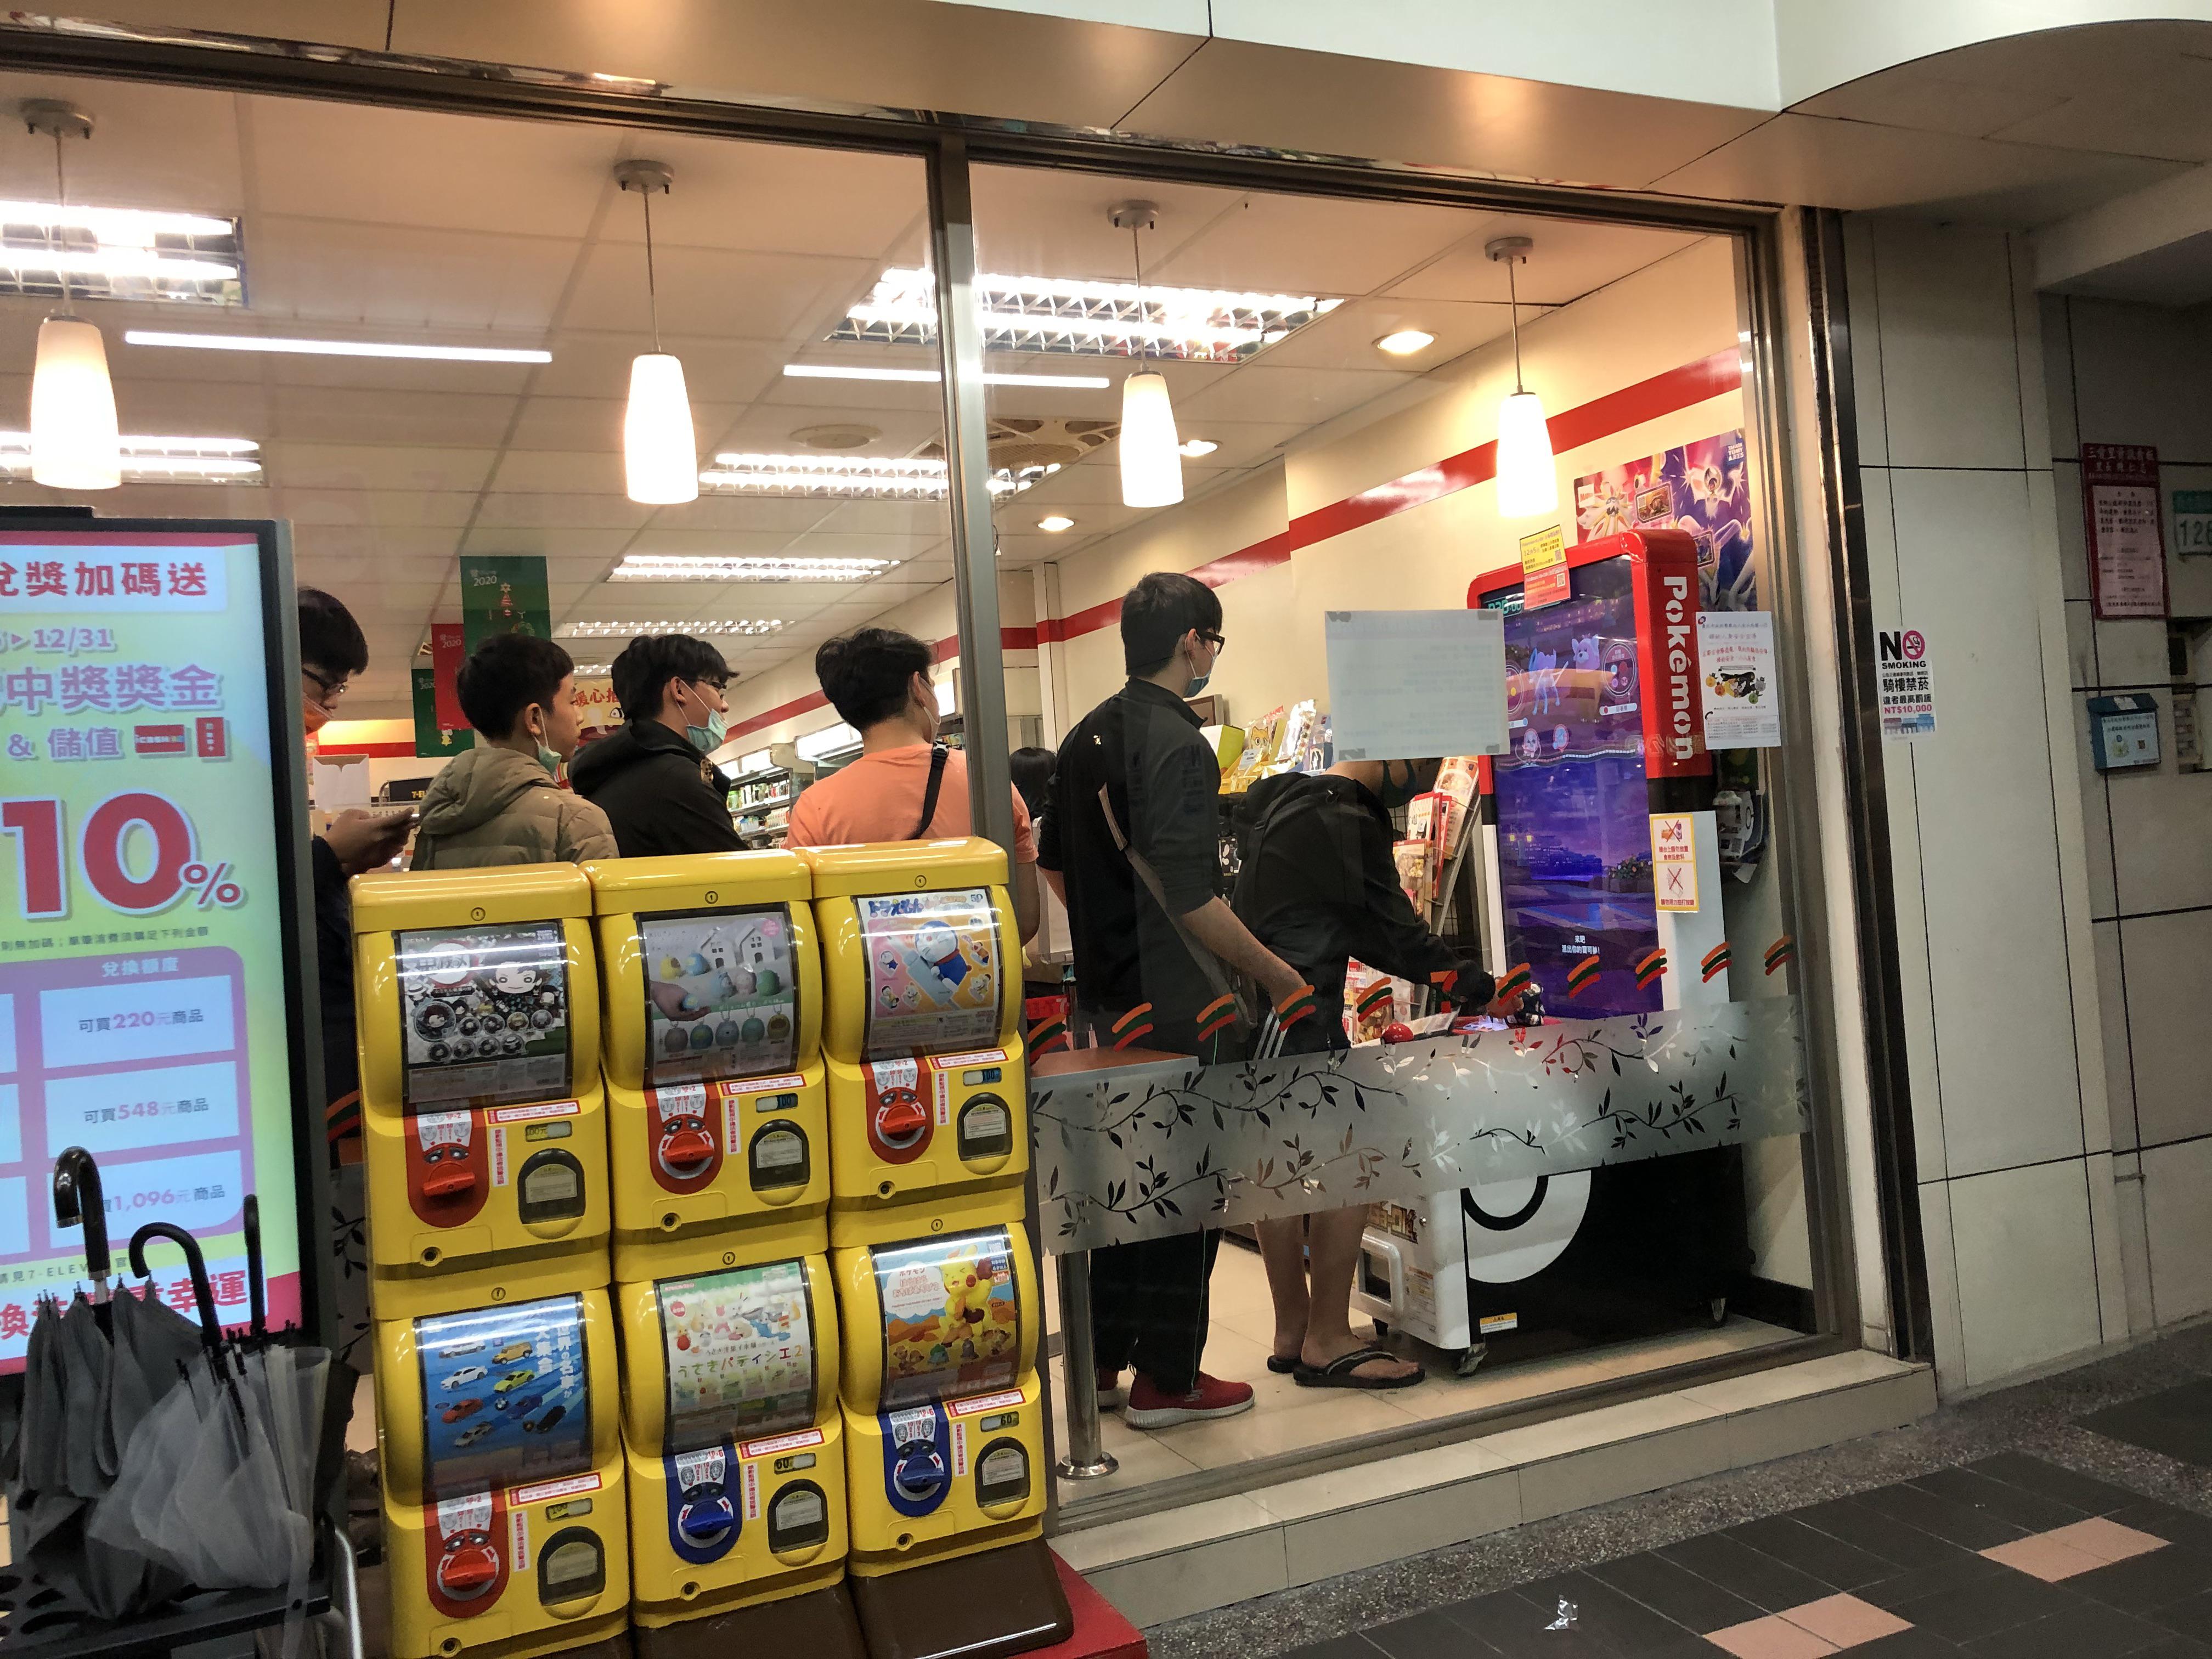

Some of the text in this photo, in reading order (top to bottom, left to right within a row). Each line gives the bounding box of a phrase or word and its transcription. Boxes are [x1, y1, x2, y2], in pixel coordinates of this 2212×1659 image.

[473, 575, 497, 586] 2020
[442, 639, 461, 648] 2020
[1663, 577, 1694, 760] Pokémon
[1882, 661, 1927, 669] SMOKING
[1883, 676, 1929, 692] 騎樓禁菸
[1884, 704, 1932, 714] NT$10,000
[78, 1008, 205, 1033] 可買220元商品
[83, 1097, 209, 1124] 可買548元商品
[1000, 1415, 1012, 1424] 60
